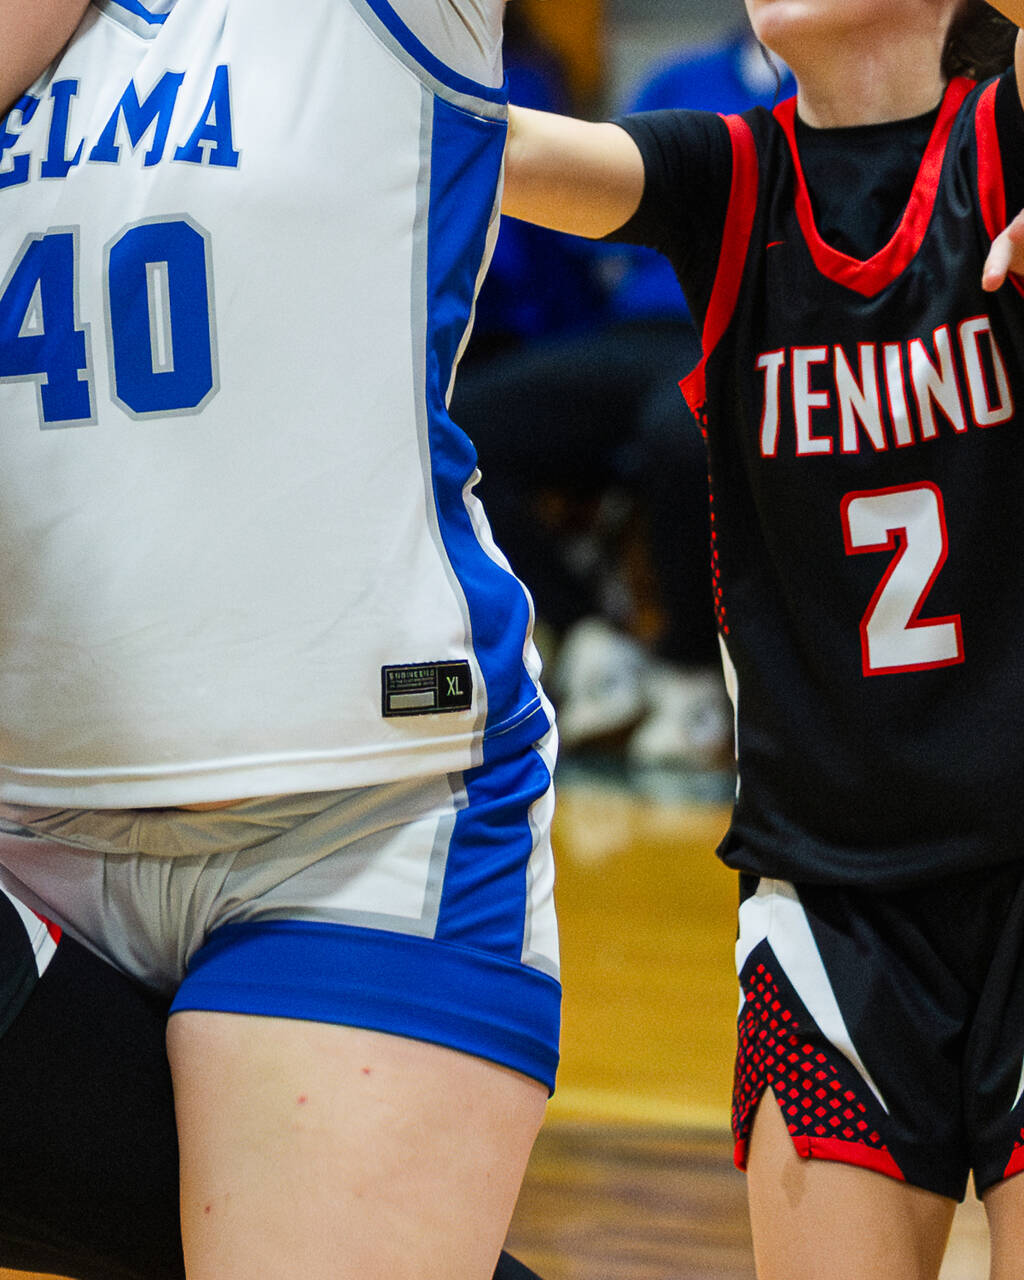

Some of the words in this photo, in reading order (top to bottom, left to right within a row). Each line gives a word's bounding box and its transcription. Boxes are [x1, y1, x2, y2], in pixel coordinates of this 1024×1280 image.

[754, 314, 1015, 458] TENINO
[840, 480, 966, 678] 2
[446, 676, 464, 697] XL
